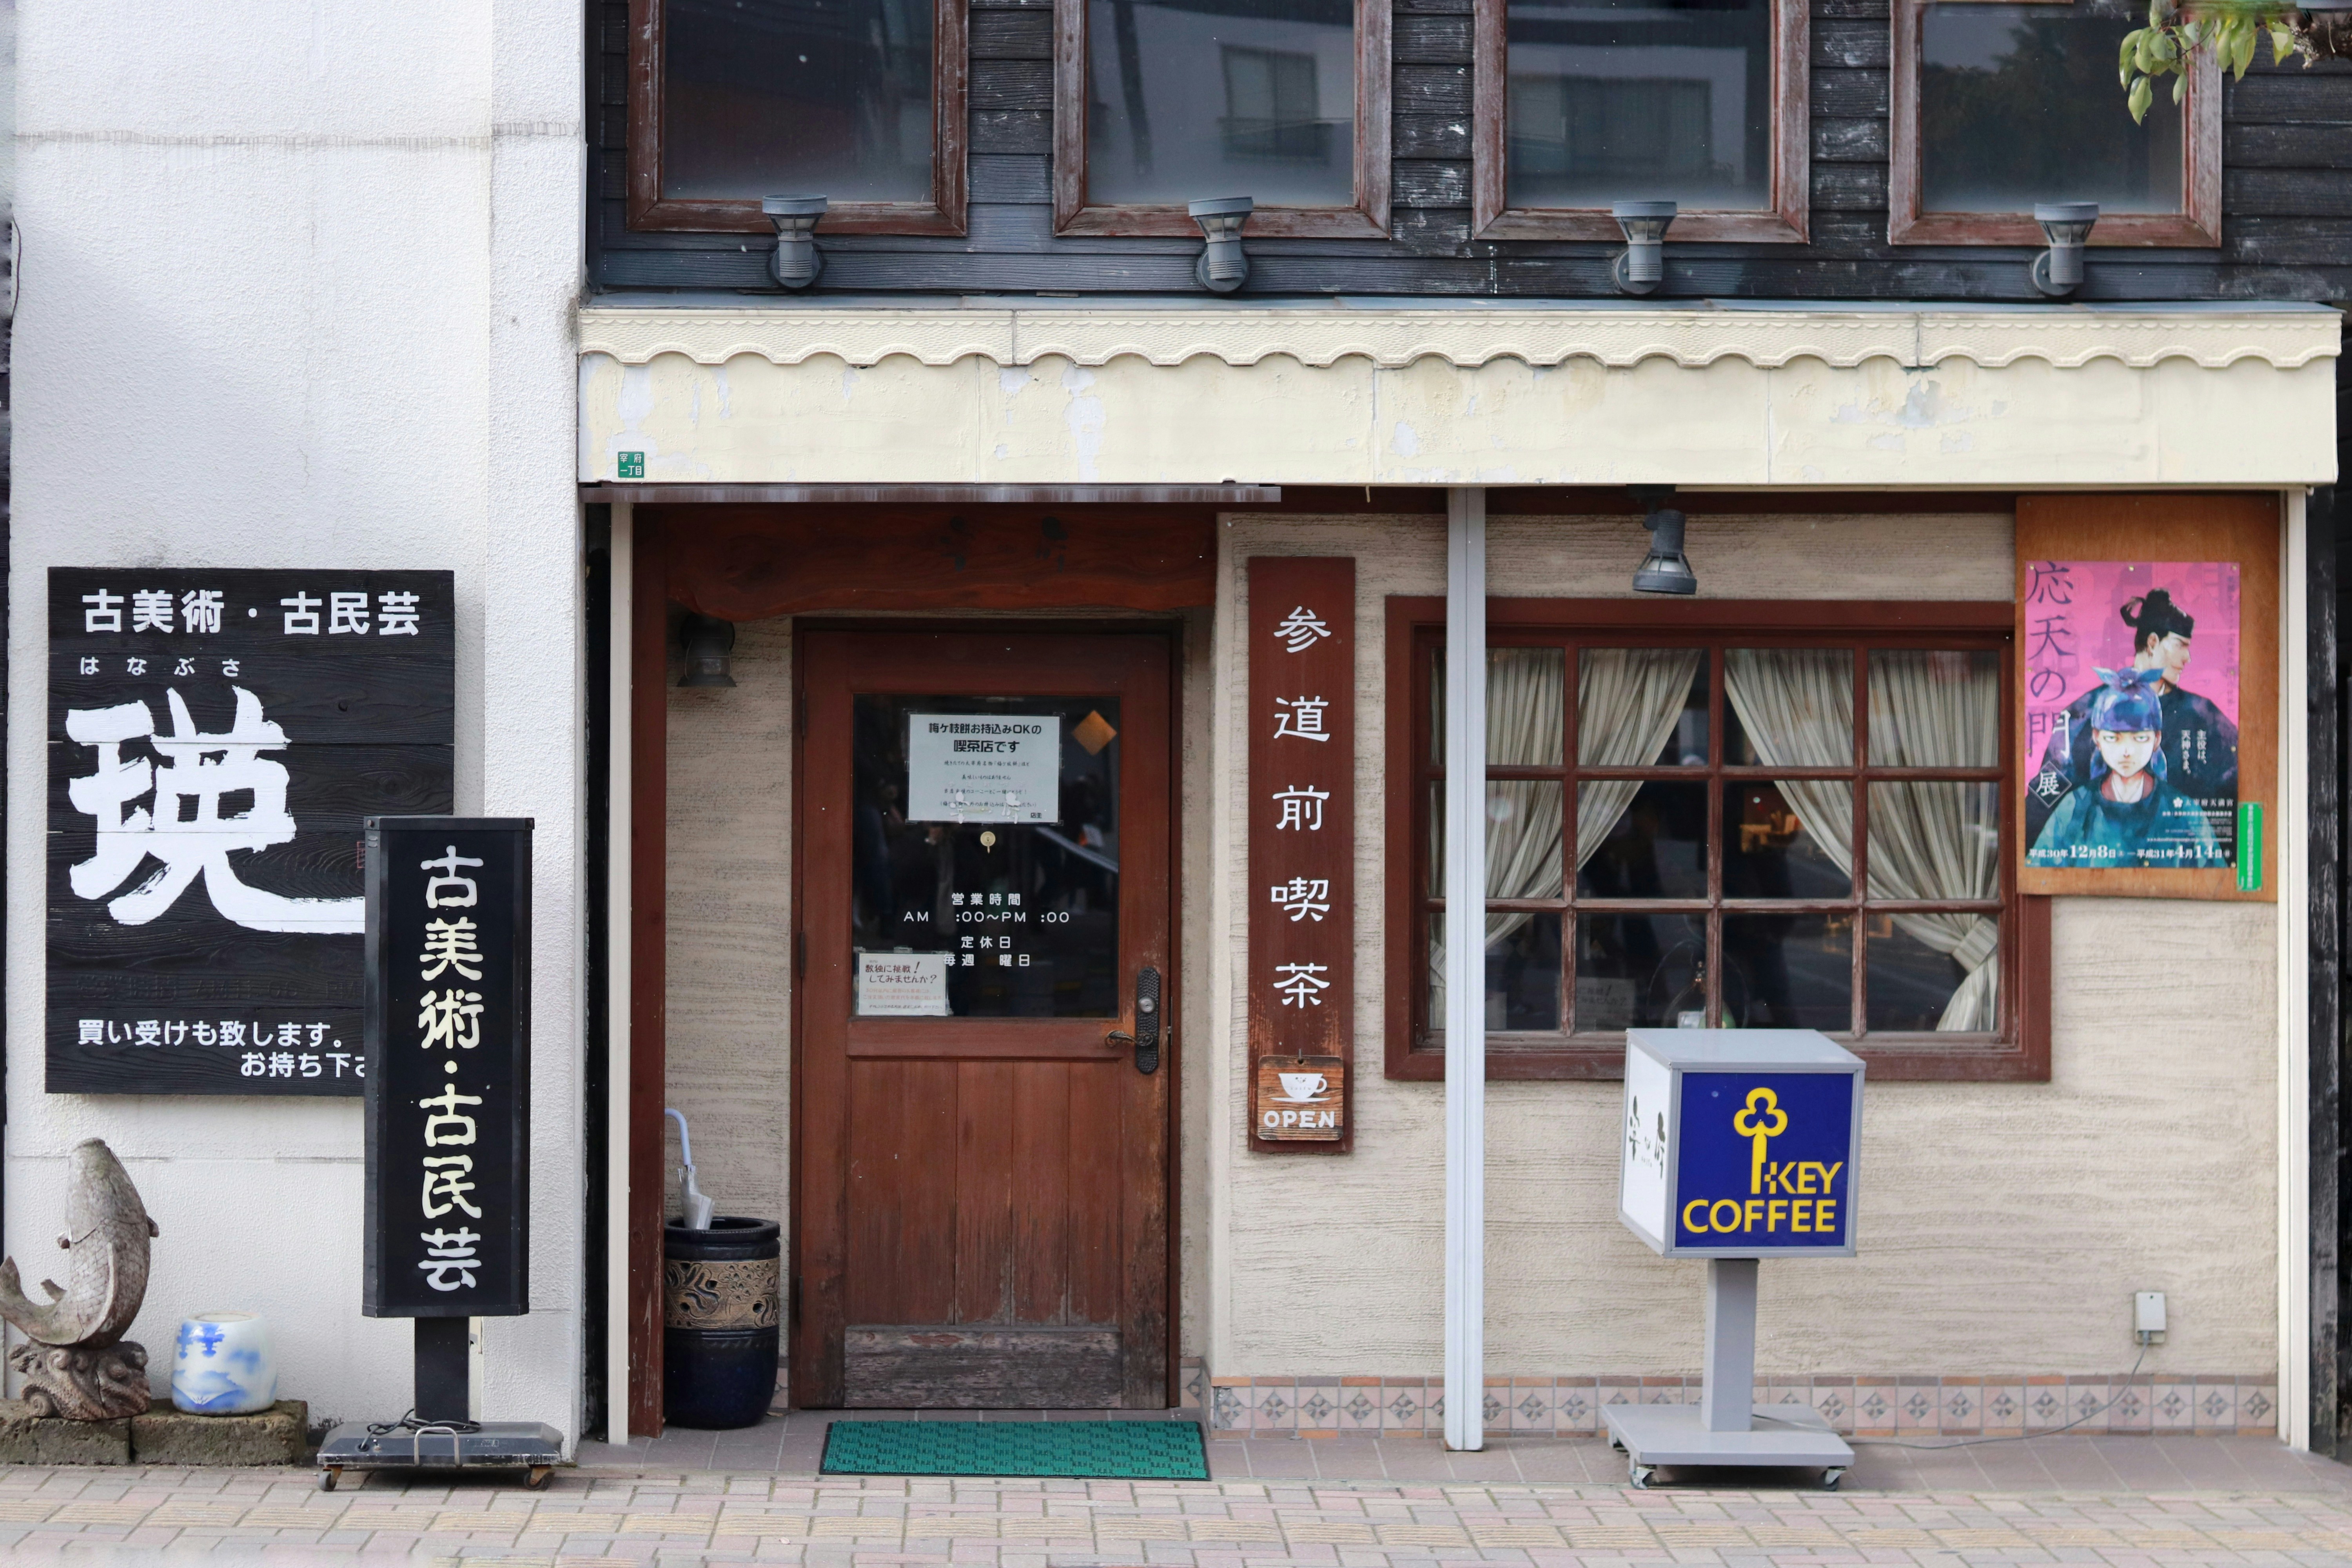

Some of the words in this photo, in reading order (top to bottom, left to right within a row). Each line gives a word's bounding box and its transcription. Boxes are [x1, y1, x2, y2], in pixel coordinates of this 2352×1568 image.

[620, 454, 642, 463] 宰府
[620, 466, 642, 475] 一丁目
[82, 588, 421, 637] 古美術・古民芸
[80, 656, 241, 678] はなぶさ
[954, 740, 1020, 753] 喫茶店です
[2036, 771, 2061, 797] 展
[1270, 606, 1332, 1009] 参道前喫茶
[951, 893, 1021, 906] 営業時間
[904, 911, 929, 922] AM
[961, 936, 1011, 949] 定休日
[869, 974, 937, 984] してみませんか？
[78, 1020, 343, 1048] 買い受けも致します。
[417, 845, 484, 1292] 古美術・古民芸
[1264, 1110, 1335, 1128] OPEN
[1764, 1161, 1843, 1194] KEY
[1683, 1199, 1837, 1233] COFFEE
